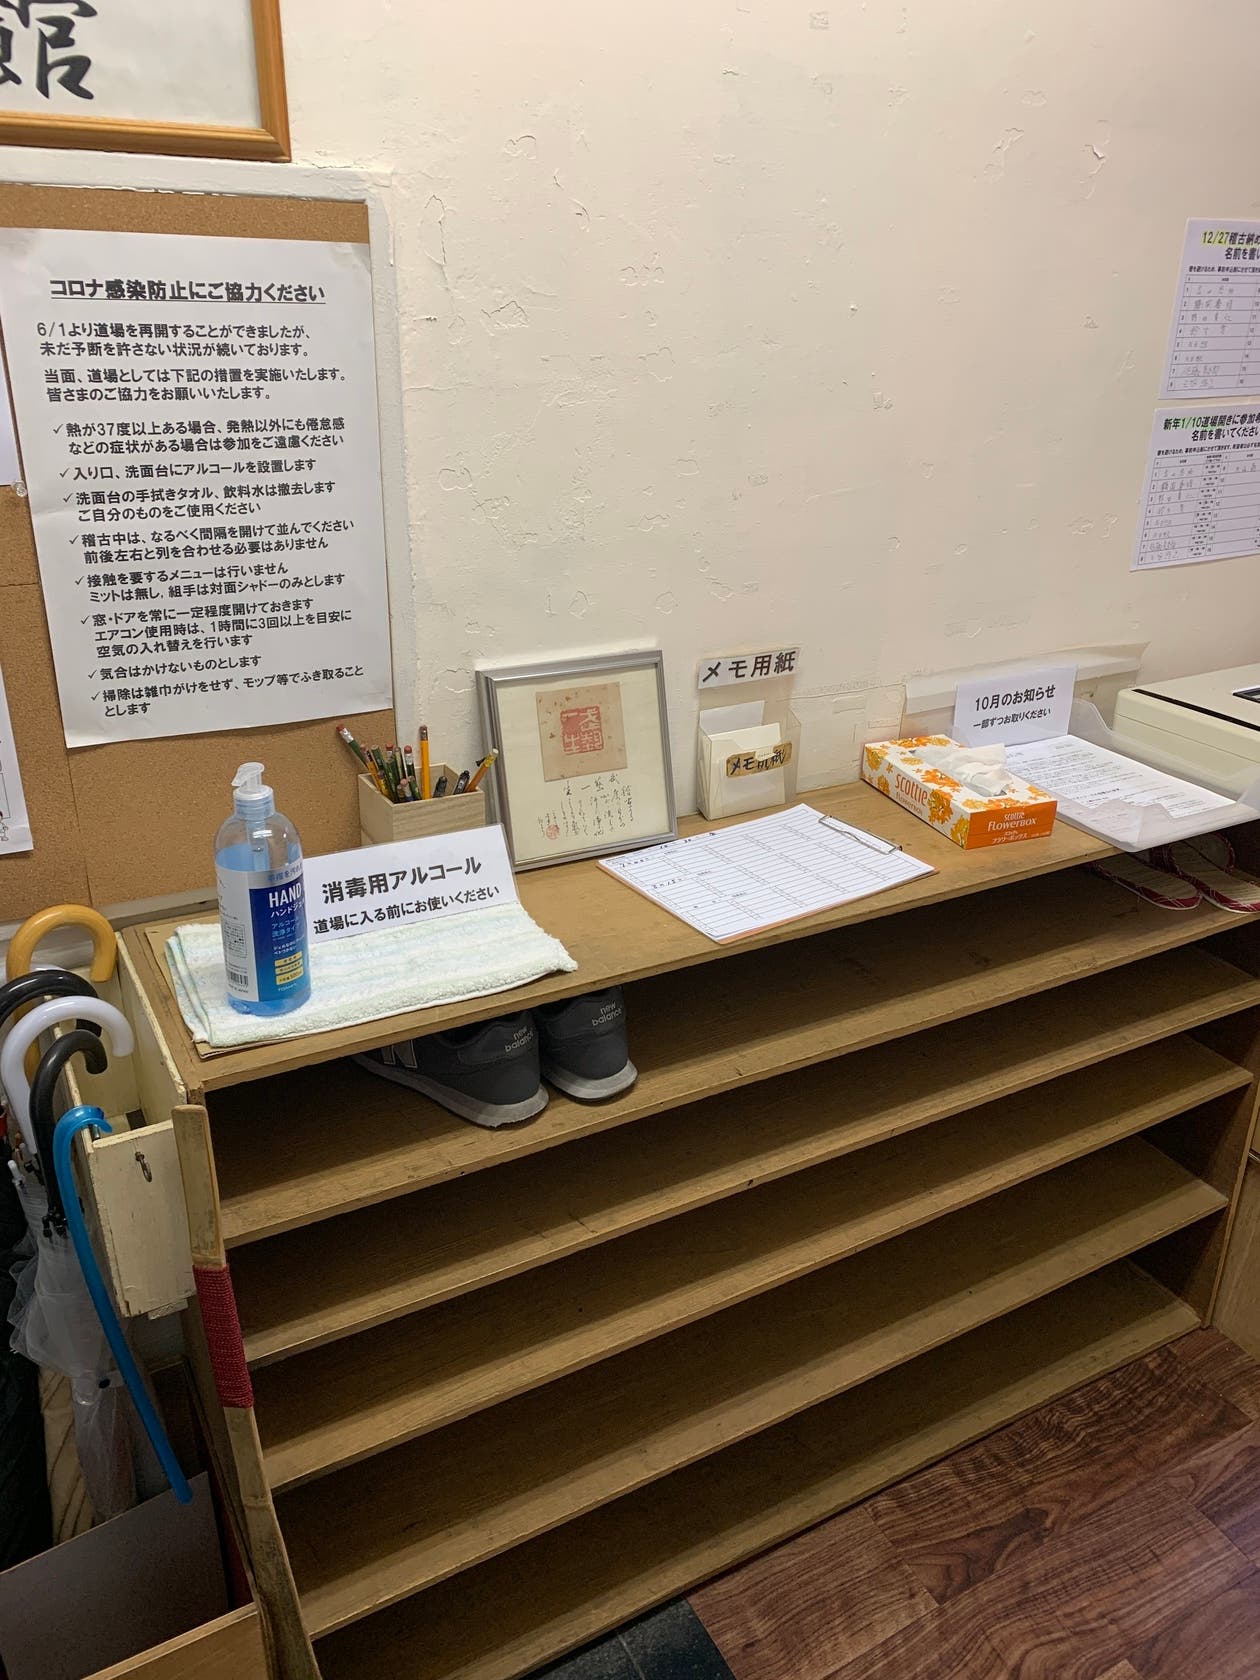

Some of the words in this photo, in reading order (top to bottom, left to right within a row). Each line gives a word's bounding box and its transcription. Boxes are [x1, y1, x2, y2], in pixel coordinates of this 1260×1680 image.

[50, 279, 325, 302] コロナ感染防止にご協力ください
[37, 322, 311, 339] 6/1より道場を再開することができましたが、
[40, 341, 308, 357] 未だ予断を許さない状況が続いております。
[44, 368, 345, 384] 当面、道場としては下記の措置を実施いたします。
[47, 386, 271, 402] 皆さまのご協力をお願いいたします。
[66, 417, 345, 437] 熱が37度以上ある場合、発熱以外にも倦怠感
[69, 435, 344, 455] などの症状がある場合は参加をご遠慮ください
[73, 458, 316, 480] 入り口、洗面台にアルコールを設置します
[76, 481, 335, 505] 洗面台の手拭きタオル、飲料水は撤去します
[78, 502, 261, 522] ご自分のものをご使用ください
[82, 519, 354, 547] 稽古中は、なるべく間隔を開けて並んでください
[84, 537, 328, 564] 前後左右と列を合わせる必要はありません
[87, 562, 288, 588] 接触を要するメニューは行いません
[93, 598, 313, 627] 窓・ドアを常に一定程度開けておきます
[95, 609, 352, 642] エアコン使用時は、1時間に3回以上を目安に
[97, 634, 252, 658] 空気の入れ替えを行います
[100, 655, 261, 681] 気合はかけないものとします
[702, 650, 797, 683] メモ用紙
[103, 665, 364, 702] 掃除は雑巾がけをせず、モップ等でふき取ること
[975, 684, 1056, 711] 10月のお知らせ
[105, 702, 151, 718] とします
[973, 708, 1051, 730] 一部ずつお取りください
[322, 856, 482, 905] 消毒用アルコール
[269, 882, 302, 908] HAND
[313, 884, 500, 935] 道場に入る前にお使いください
[591, 1008, 622, 1027] balance
[600, 1001, 616, 1016] new
[505, 1031, 534, 1053] balance
[513, 1025, 528, 1041] new
